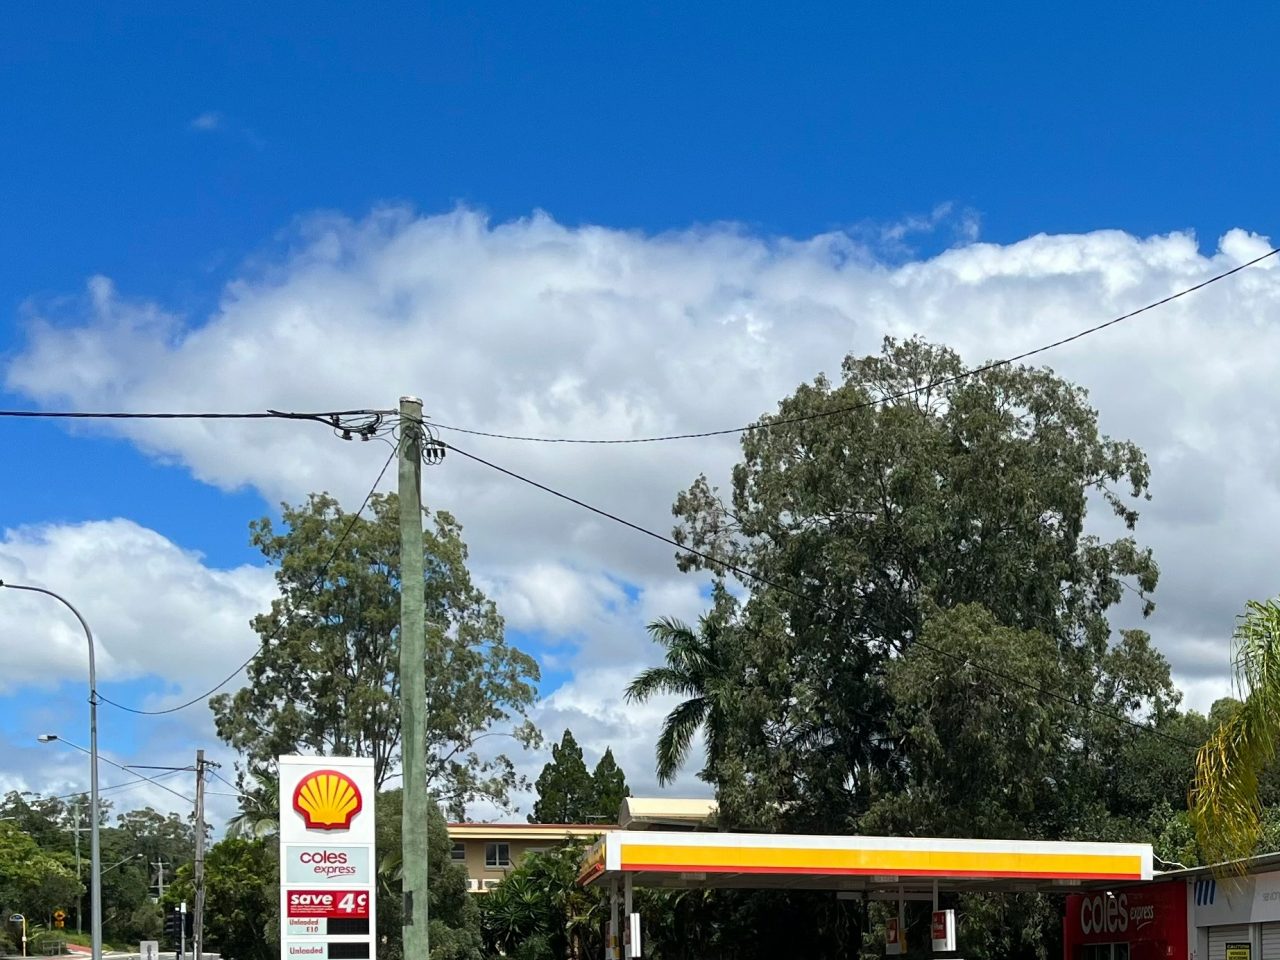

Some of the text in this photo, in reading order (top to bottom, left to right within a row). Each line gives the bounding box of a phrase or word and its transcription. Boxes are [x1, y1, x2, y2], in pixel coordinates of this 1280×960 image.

[300, 850, 347, 864] coles
[314, 865, 356, 876] express
[290, 894, 333, 905] save
[1080, 890, 1129, 935] coles
[289, 946, 323, 955] Unleaded
